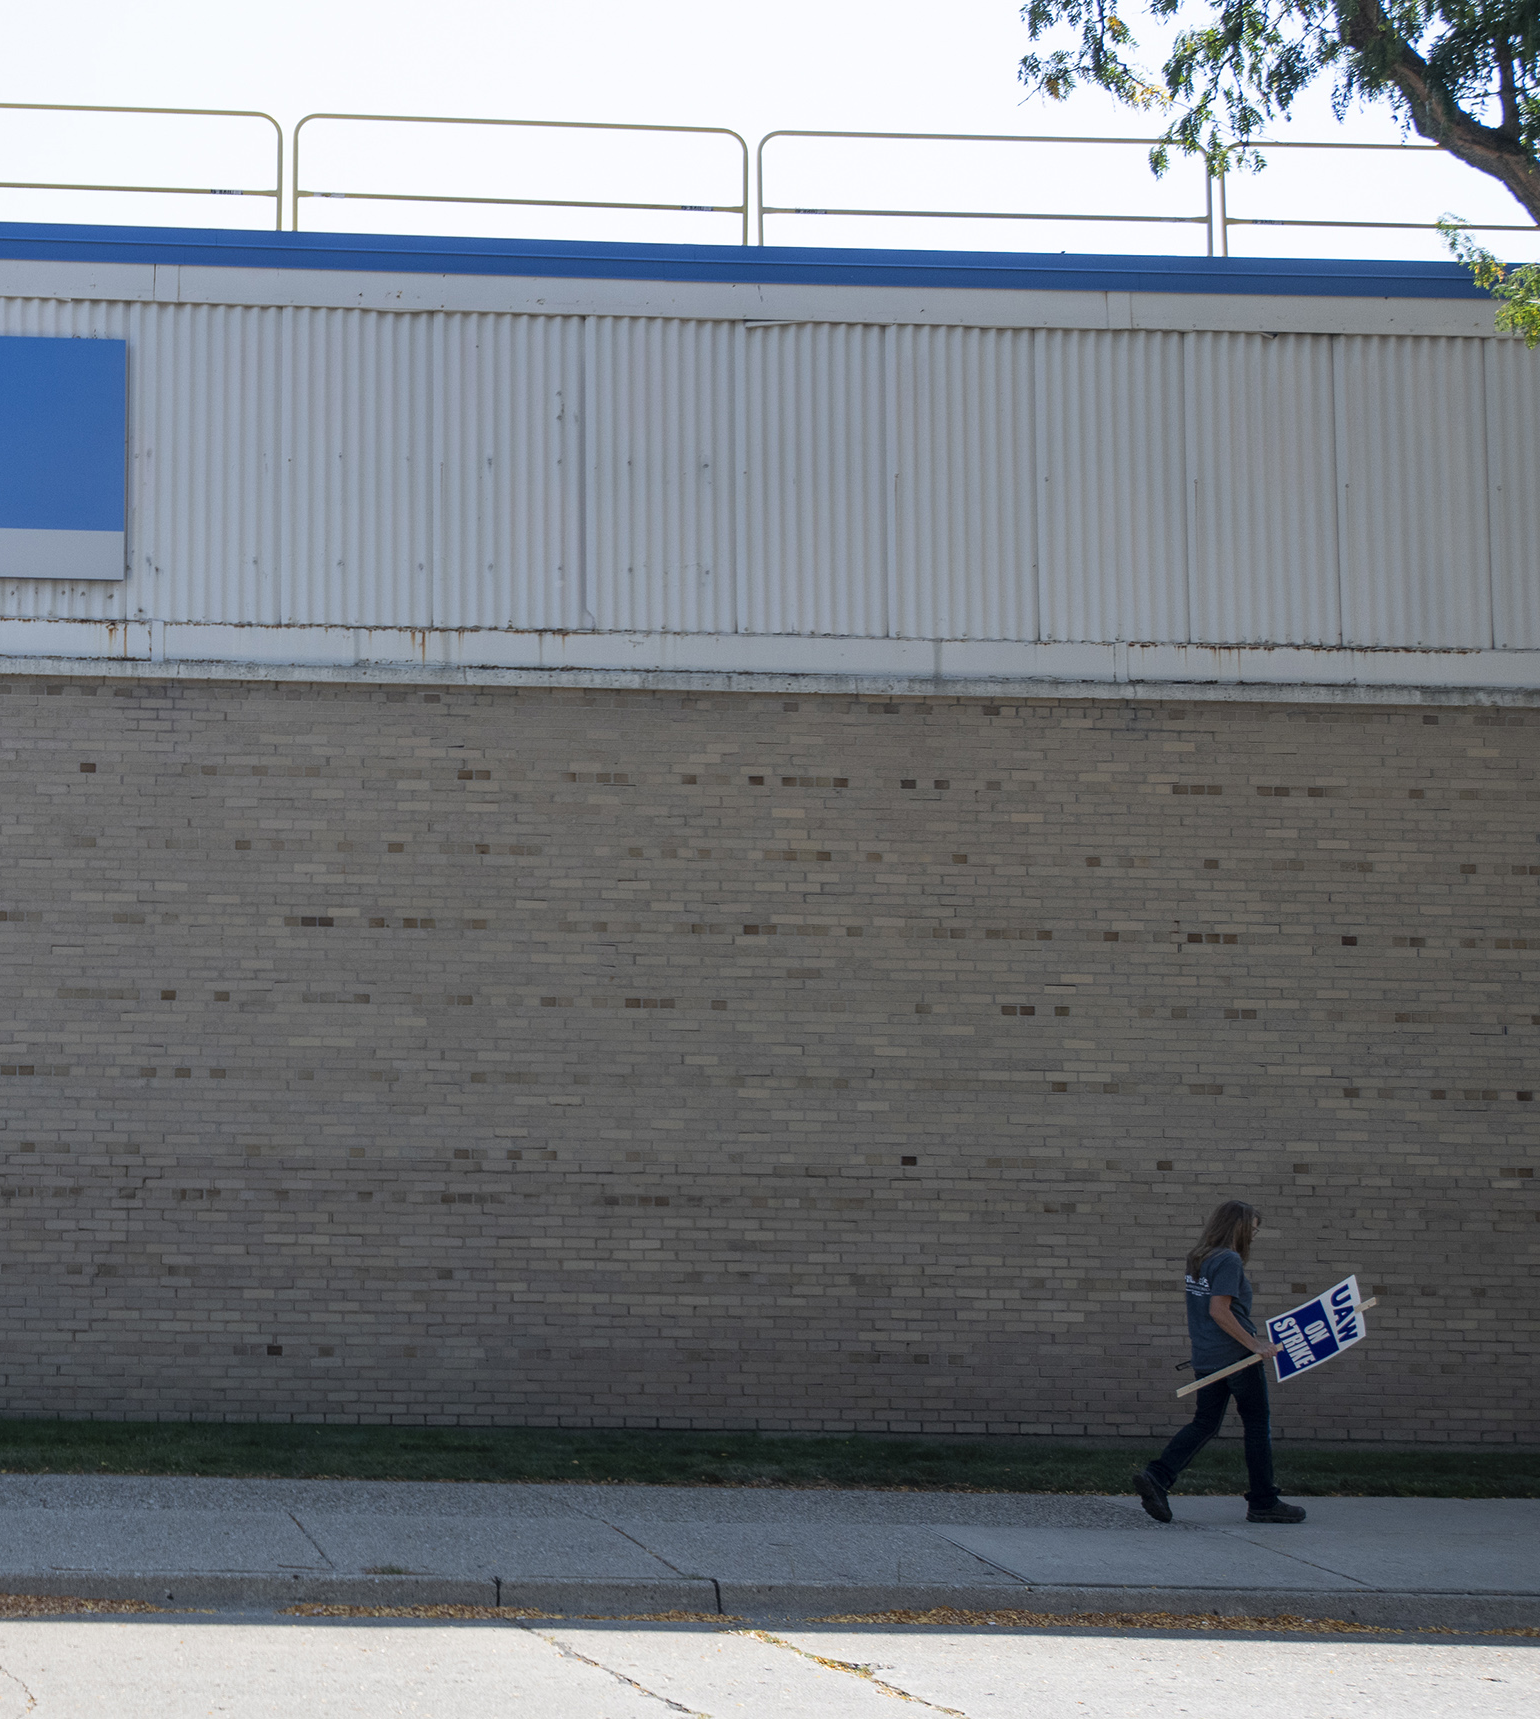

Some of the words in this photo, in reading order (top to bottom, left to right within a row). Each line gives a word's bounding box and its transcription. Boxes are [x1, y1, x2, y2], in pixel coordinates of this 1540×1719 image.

[1303, 1319, 1331, 1345] ON
[1330, 1283, 1359, 1343] UAW
[1273, 1316, 1317, 1369] STRIKE
